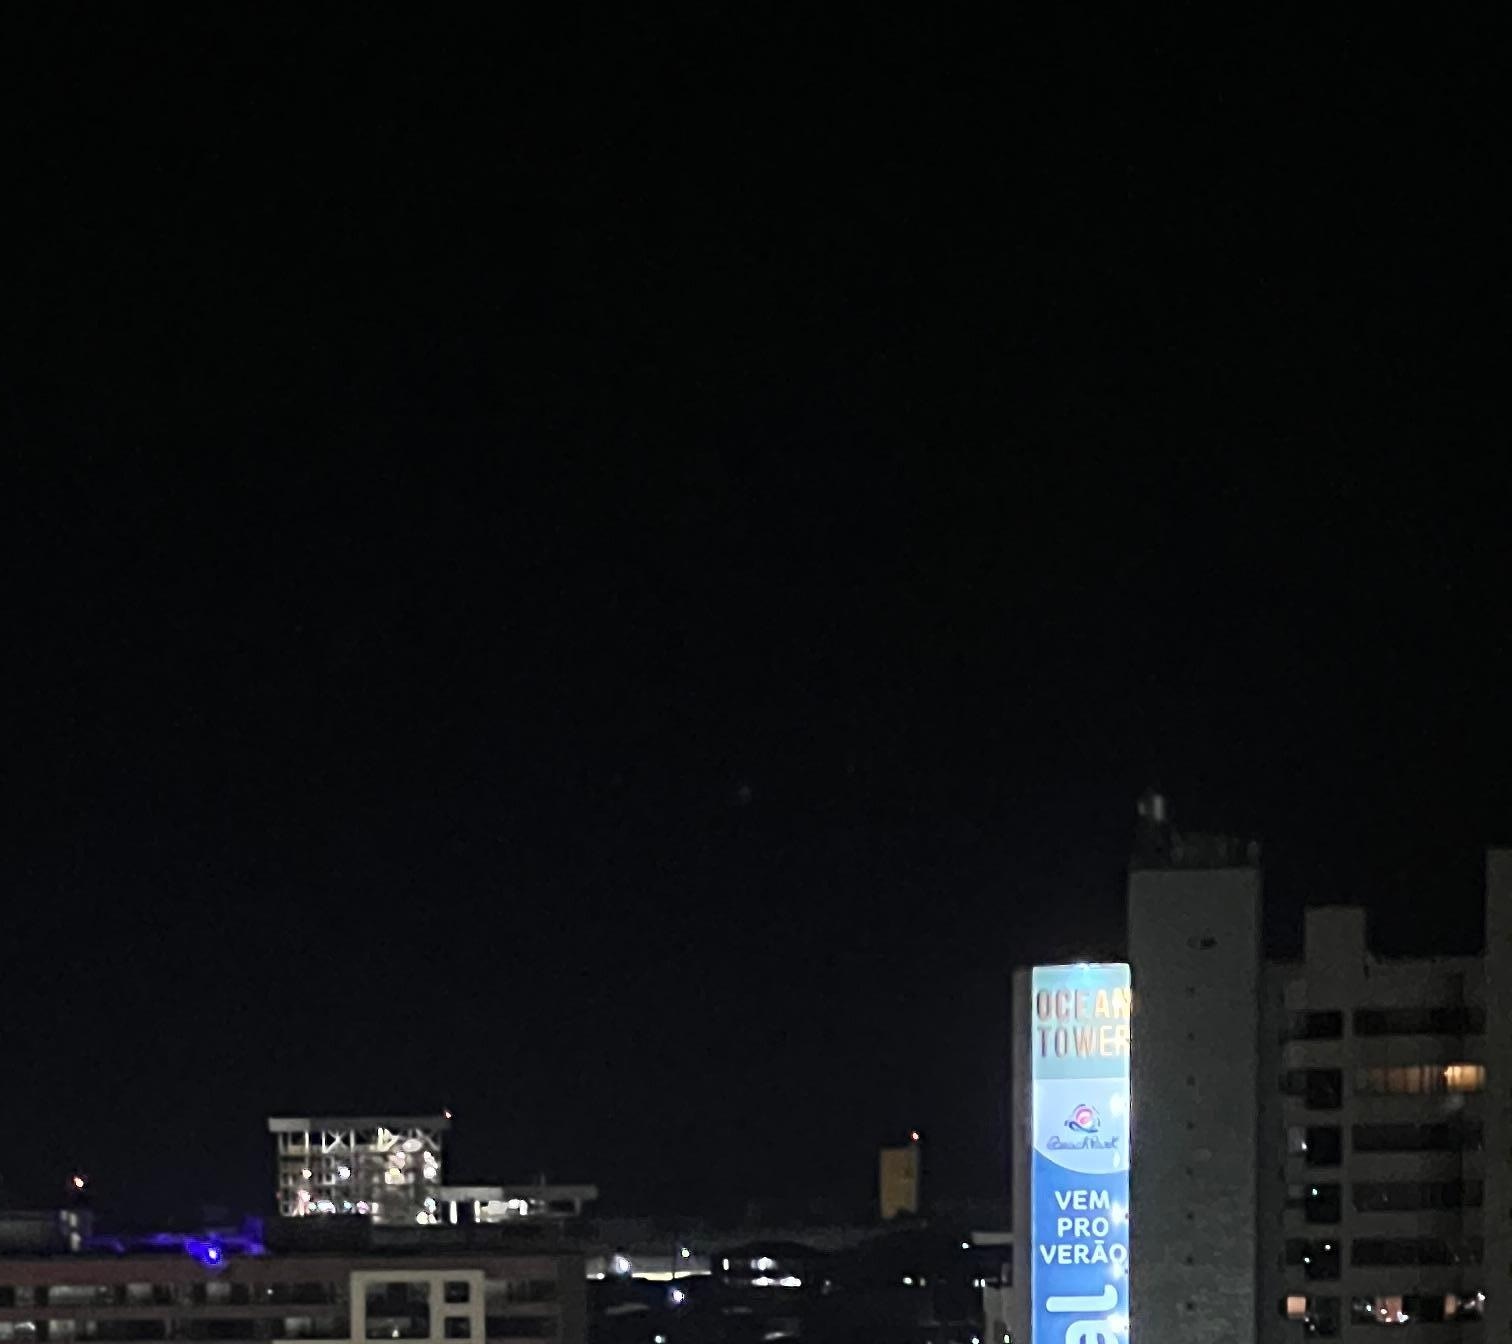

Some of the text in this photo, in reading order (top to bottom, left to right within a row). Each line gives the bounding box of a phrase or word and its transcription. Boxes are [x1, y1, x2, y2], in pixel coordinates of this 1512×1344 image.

[1036, 987, 1132, 1021] OCEAN
[1037, 1024, 1131, 1058] TOWER
[1054, 1189, 1110, 1211] VEM
[1057, 1216, 1109, 1238] PRO
[1039, 1240, 1128, 1265] VERÃO
